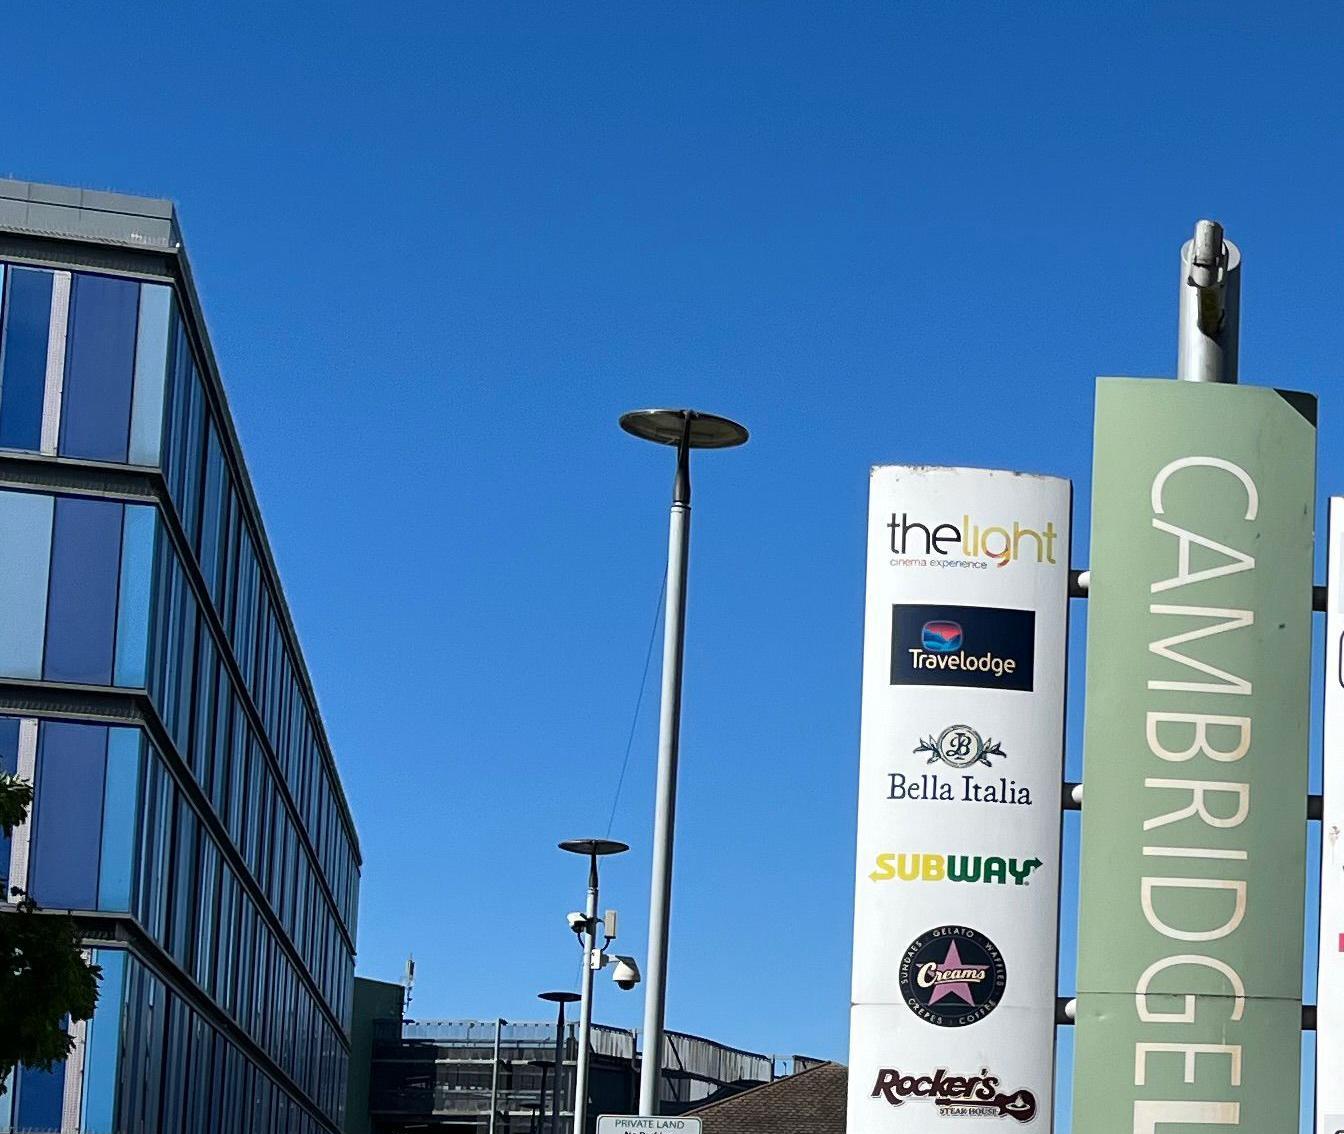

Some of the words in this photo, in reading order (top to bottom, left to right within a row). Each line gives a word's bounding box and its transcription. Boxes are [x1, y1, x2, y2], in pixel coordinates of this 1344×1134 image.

[890, 558, 926, 567] cinema
[930, 559, 987, 569] experience
[909, 649, 1016, 676] Travelodge
[887, 773, 954, 800] Bella
[961, 776, 1032, 805] Italia
[868, 854, 1043, 885] SUBWAY
[933, 928, 975, 937] GELATO
[917, 962, 986, 988] Creams
[871, 1068, 1000, 1106] Rocker's
[615, 1119, 654, 1128] PRIVATE
[656, 1120, 685, 1129] LAND
